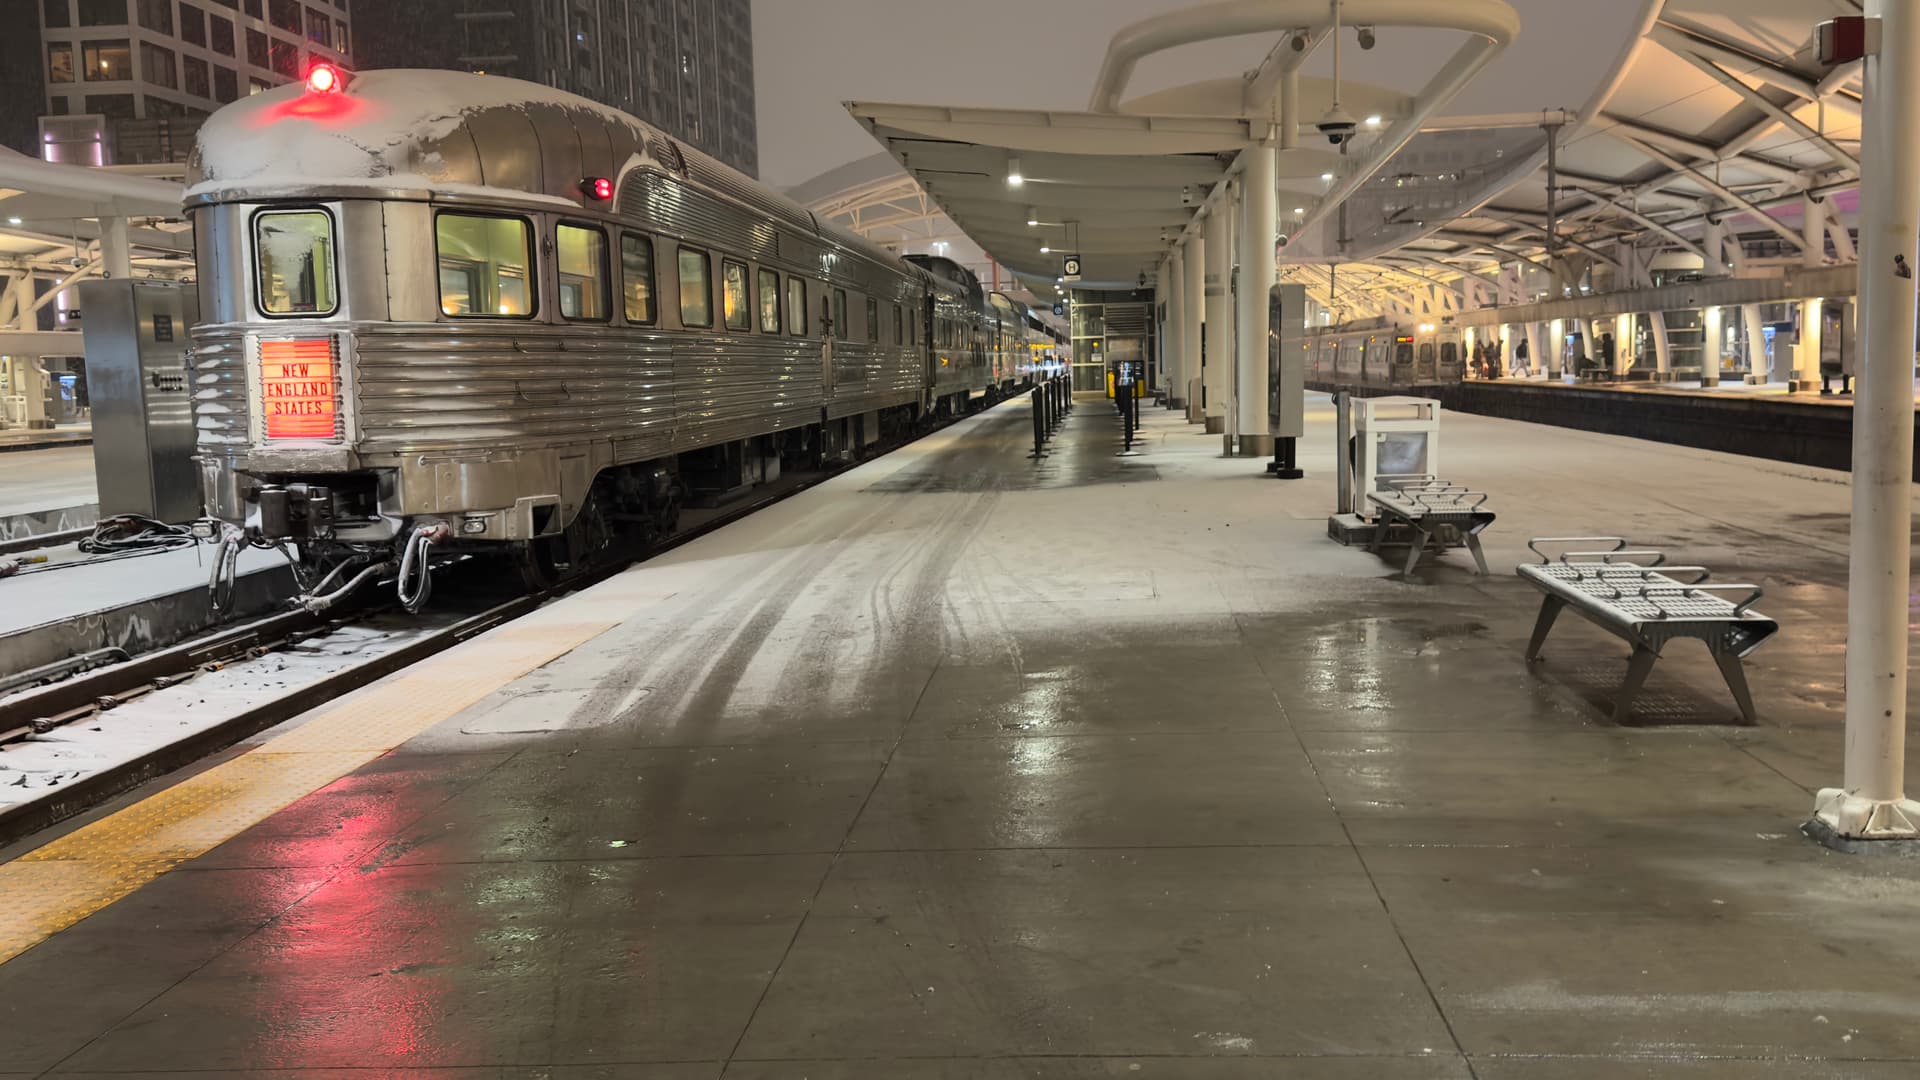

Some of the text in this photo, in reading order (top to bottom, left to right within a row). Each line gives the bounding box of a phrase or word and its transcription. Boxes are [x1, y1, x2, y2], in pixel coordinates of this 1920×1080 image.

[282, 363, 309, 377] NEW
[268, 382, 328, 397] ENGLAND
[275, 401, 322, 415] STATES
